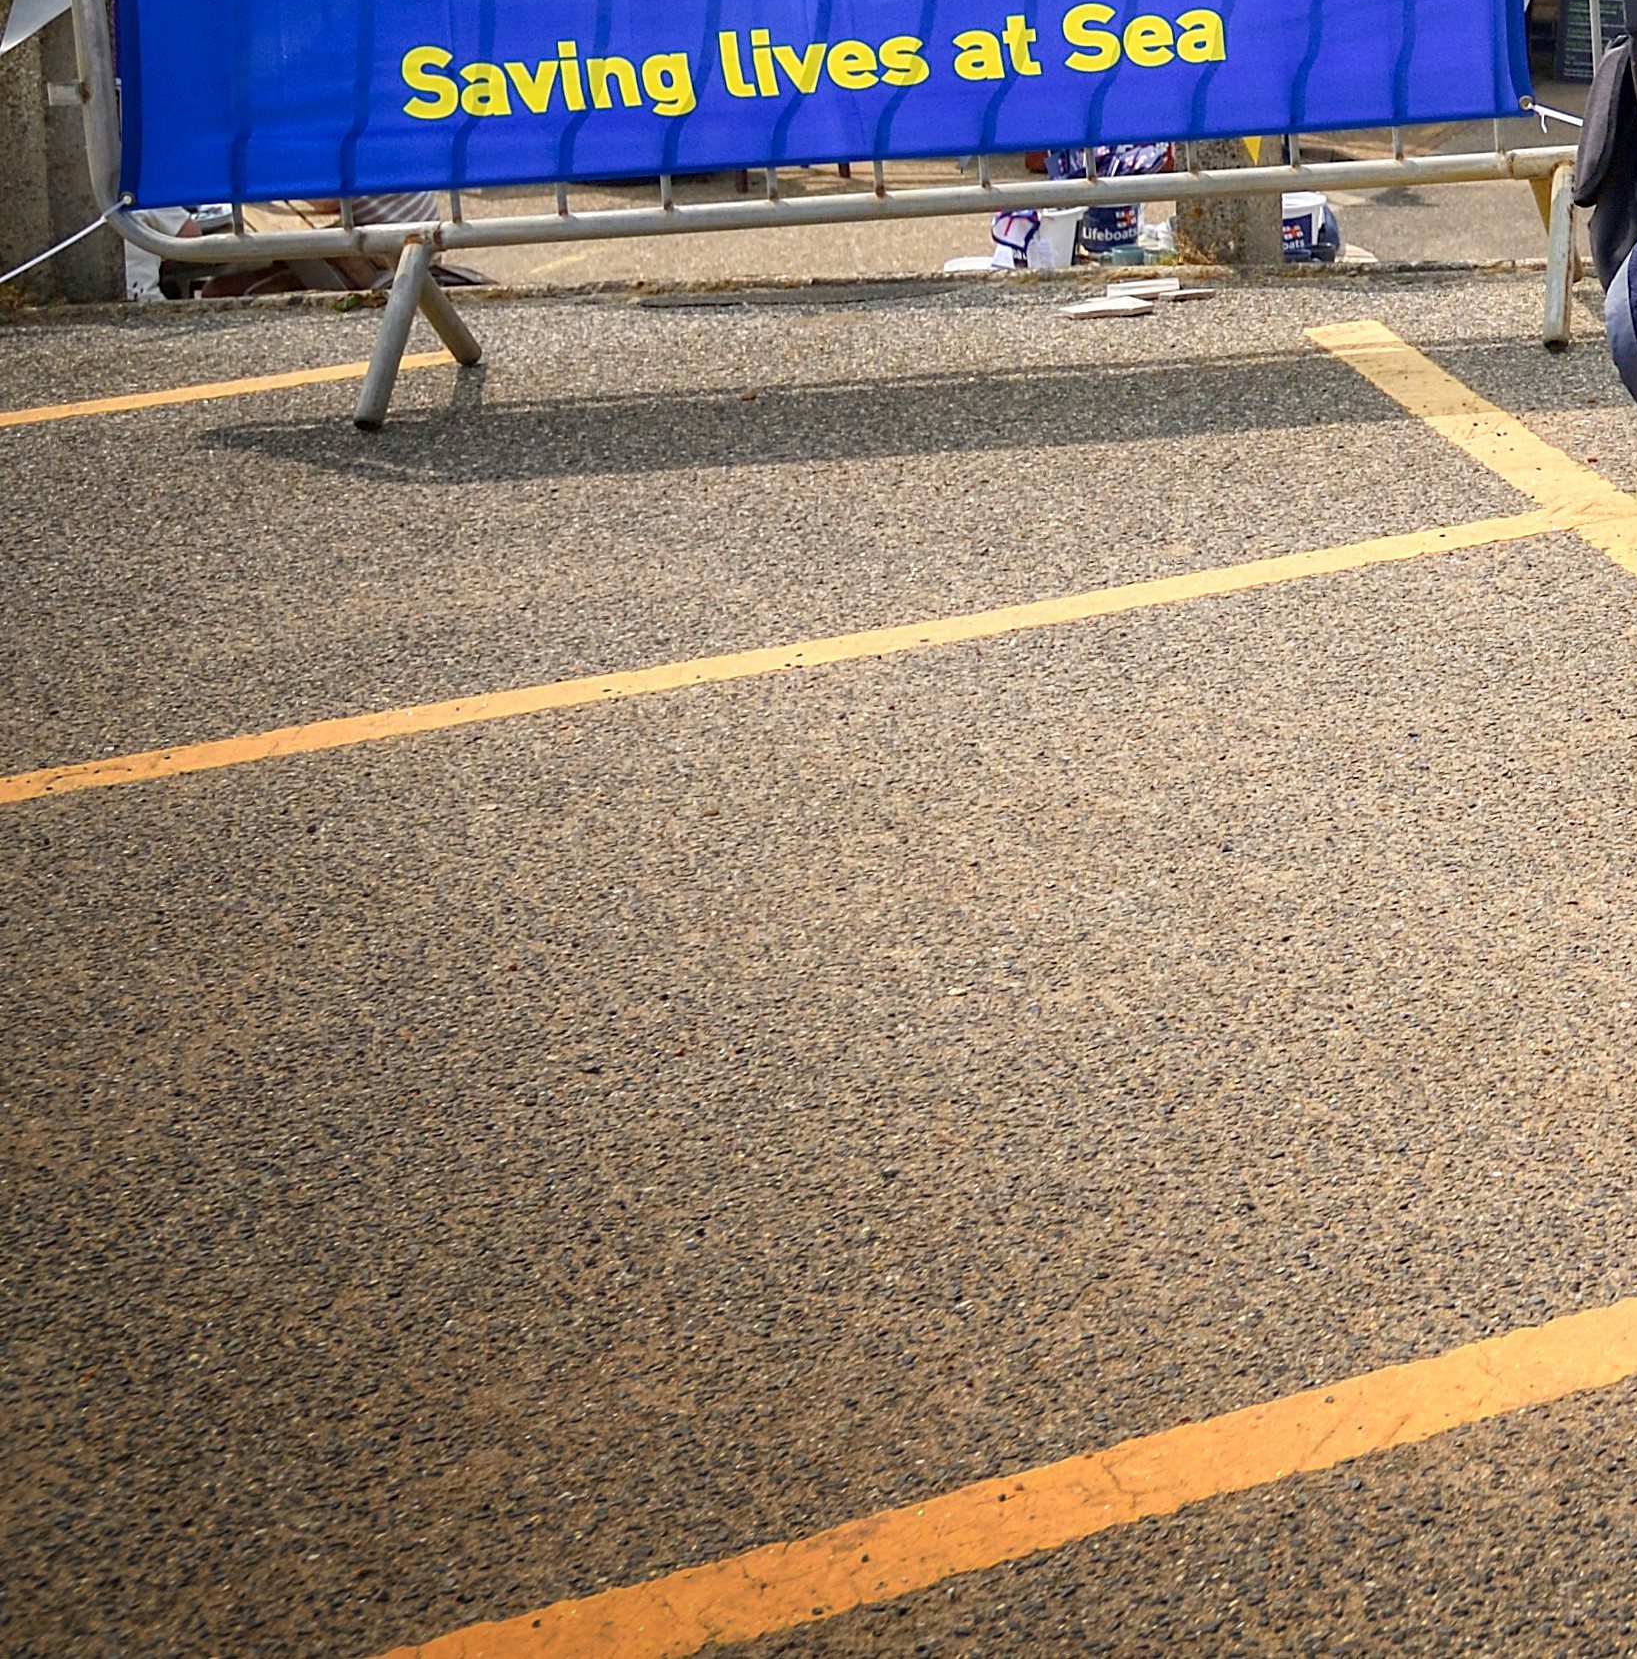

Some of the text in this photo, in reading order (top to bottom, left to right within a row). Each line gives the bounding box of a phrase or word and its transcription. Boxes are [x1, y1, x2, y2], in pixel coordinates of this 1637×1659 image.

[403, 5, 1224, 118] Saving lives at Sea
[1082, 226, 1138, 242] Lifeboats
